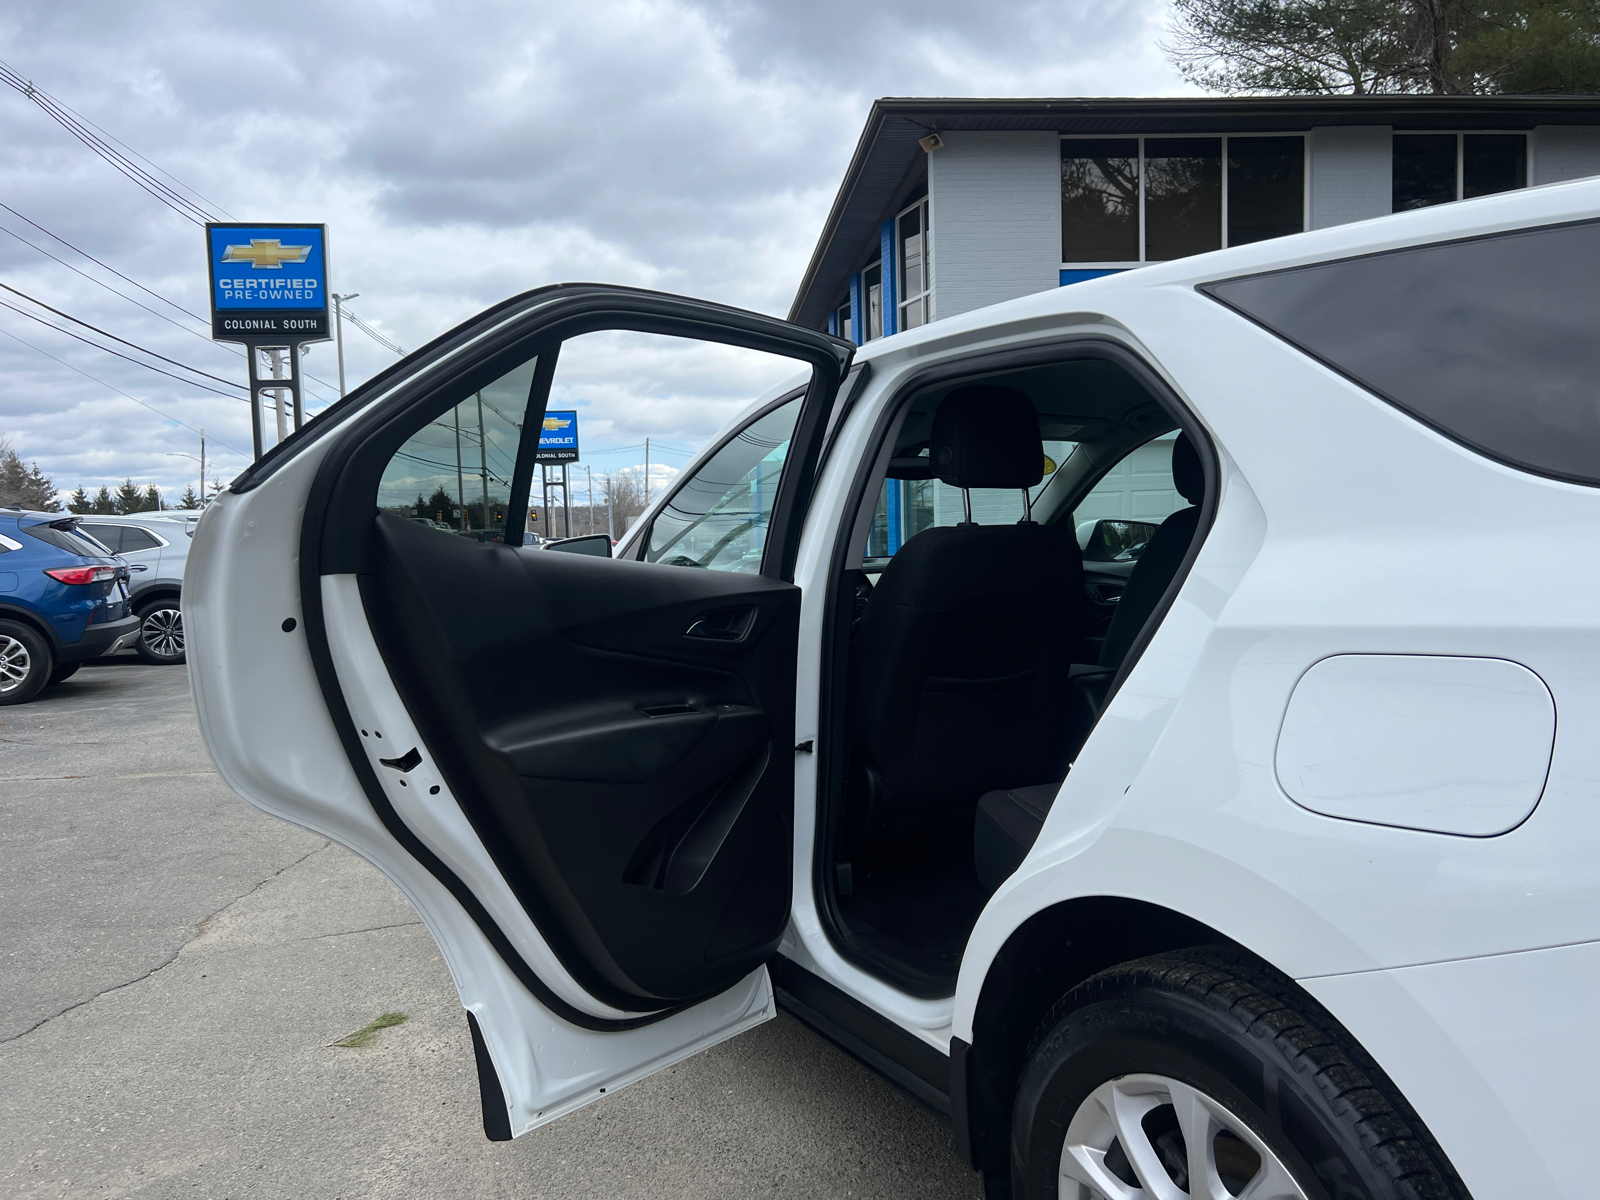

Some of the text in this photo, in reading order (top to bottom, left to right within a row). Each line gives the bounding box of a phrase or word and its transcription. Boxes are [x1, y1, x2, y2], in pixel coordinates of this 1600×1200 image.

[219, 279, 318, 289] CERTIFIED
[225, 290, 313, 299] PRE-OWNED
[224, 319, 317, 329] COLONIAL SOUTH
